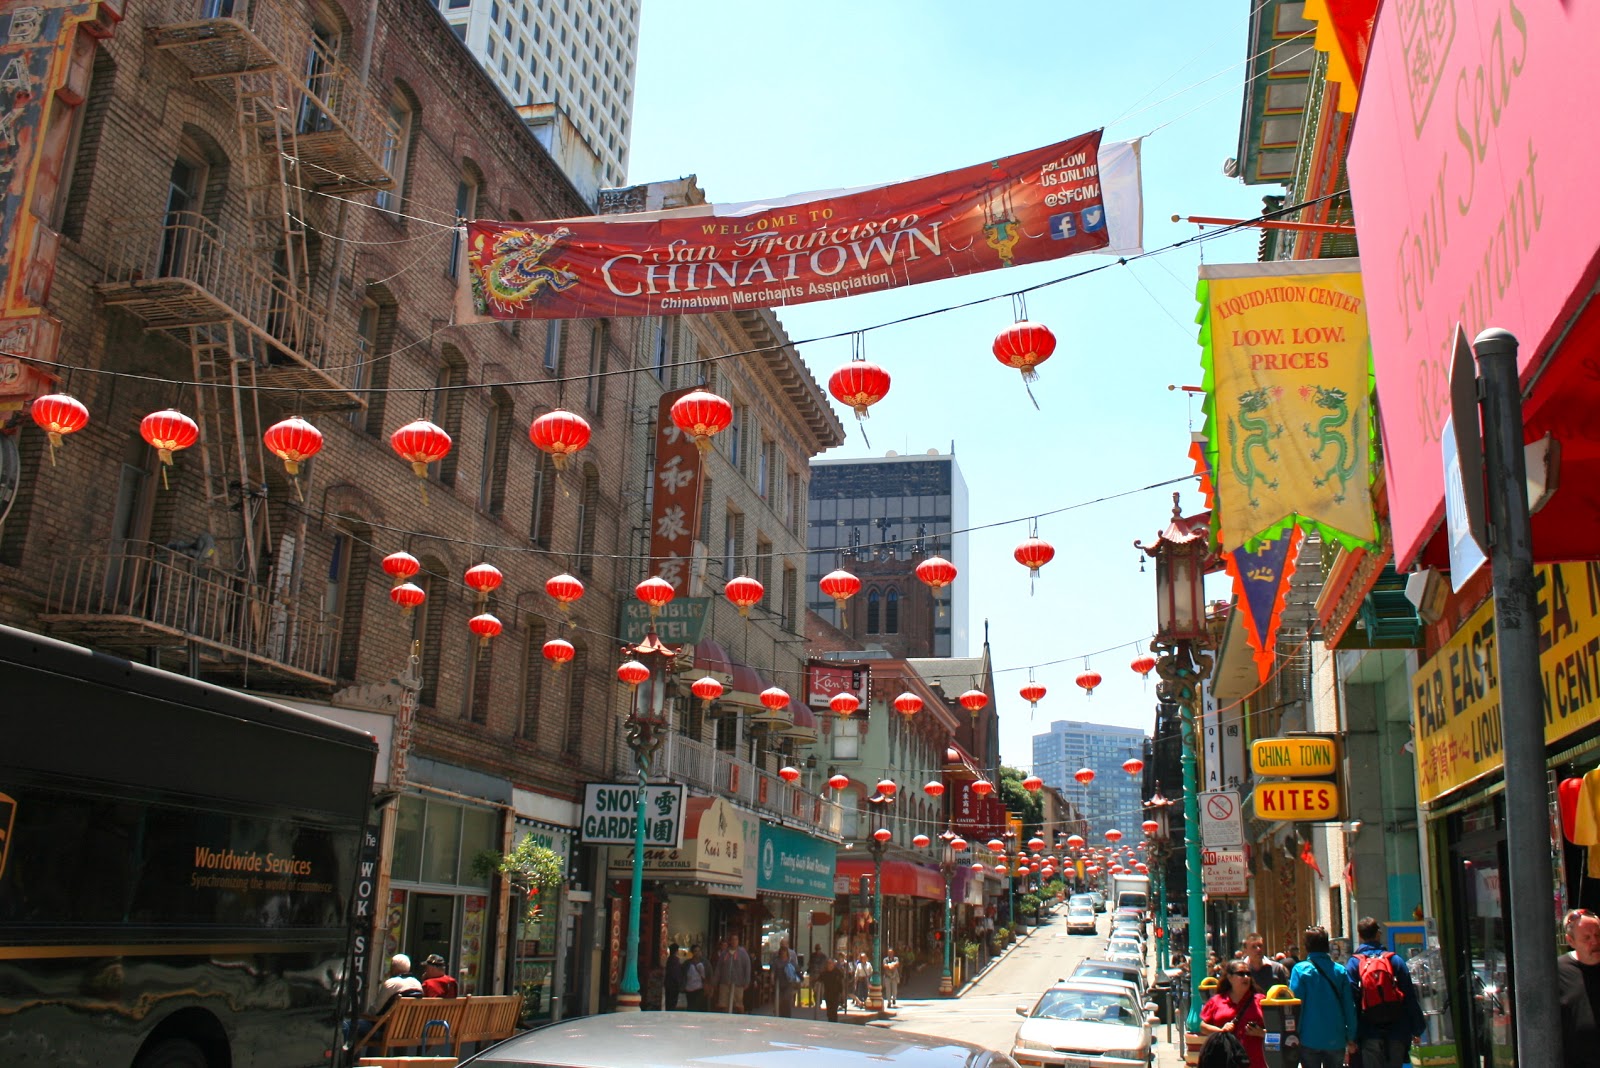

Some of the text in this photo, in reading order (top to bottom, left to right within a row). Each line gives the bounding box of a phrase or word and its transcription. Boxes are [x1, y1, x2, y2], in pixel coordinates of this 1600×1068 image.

[1041, 152, 1086, 172] FOLLOW
[1397, 0, 1528, 343] Four Seas
[1041, 173, 1057, 187] US
[1044, 183, 1100, 207] @SFCMA
[702, 207, 834, 236] WELCOME TO
[651, 213, 920, 265] San Francisco
[601, 221, 943, 297] CHINATOWN
[660, 271, 889, 309] Chinatown Merchants Association
[1216, 286, 1361, 320] LIQUIDATION CENTER
[1232, 326, 1346, 347] LOW. LOW.
[1251, 352, 1329, 371] PRICES
[627, 603, 703, 618] REUBLIC
[627, 621, 691, 639] HOTEL
[814, 669, 850, 693] Kan's
[1417, 668, 1447, 741] FAR
[1258, 745, 1331, 767] CHINA TOWN
[1263, 789, 1330, 811] KITES
[585, 815, 652, 840] GARDEN
[653, 790, 677, 843] 雪園
[195, 846, 312, 875] Worldwide Services
[658, 860, 691, 868] COCKTAILS
[1203, 852, 1243, 864] NO PARKING
[191, 872, 249, 892] Synchronizing
[250, 877, 263, 889] the
[265, 879, 288, 891] world
[297, 881, 333, 893] commerce
[357, 862, 374, 916] WOK
